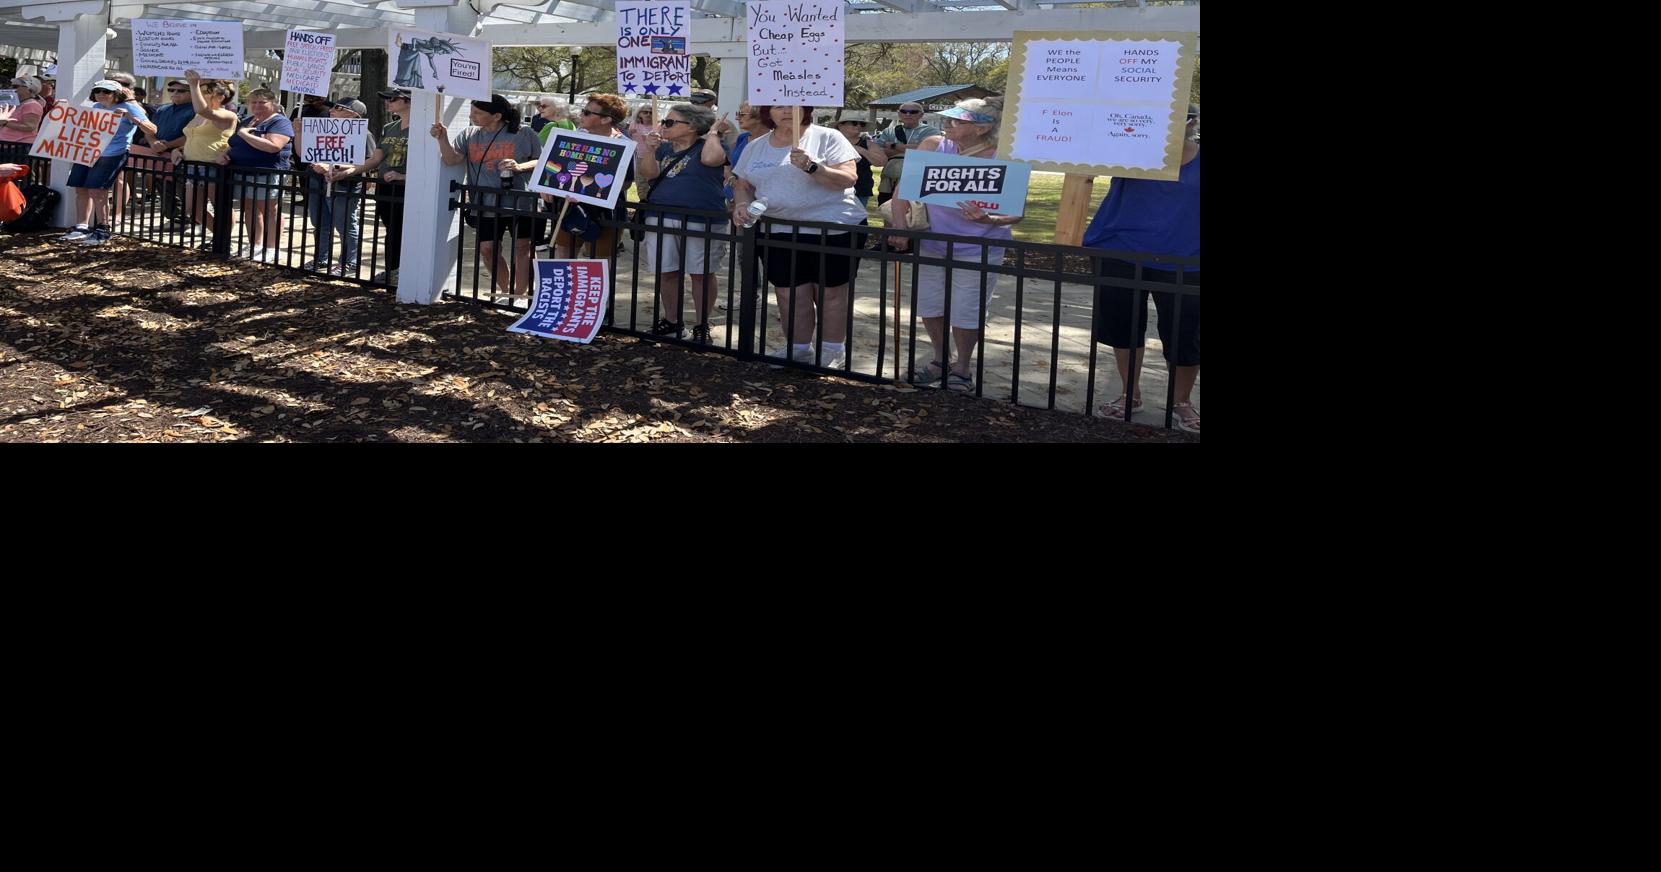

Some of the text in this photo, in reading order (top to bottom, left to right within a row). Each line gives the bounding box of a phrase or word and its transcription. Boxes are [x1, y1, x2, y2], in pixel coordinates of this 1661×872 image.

[620, 6, 684, 26] THERE
[750, 3, 838, 27] You Wanted
[290, 32, 332, 45] HANDS OFF
[620, 26, 680, 36] IS ONLY
[760, 28, 826, 42] Cheap Eggs
[618, 36, 650, 48] ONE
[452, 60, 476, 70] You're
[620, 55, 690, 72] IMMIGRANT
[758, 58, 783, 68] Got
[452, 69, 475, 77] Fired!
[619, 70, 690, 85] TO DEPORT
[773, 69, 821, 80] Measles
[784, 84, 828, 97] Instead
[48, 106, 122, 135] ORANGE
[304, 118, 366, 135] HANDS OFF
[58, 126, 101, 148] LIES
[316, 136, 346, 150] FREE
[36, 138, 102, 163] MATTER
[305, 145, 354, 163] SPEECH!
[559, 141, 616, 158] HATE HAS NO
[559, 150, 609, 165] HOME HERE
[928, 168, 1001, 180] RIGHTS
[925, 180, 998, 192] FOR ALL
[532, 278, 552, 319] RACISTS
[538, 269, 564, 328] DEPORT THE
[562, 266, 588, 333] IMMIGRANTS
[582, 277, 601, 326] KEEP THE
